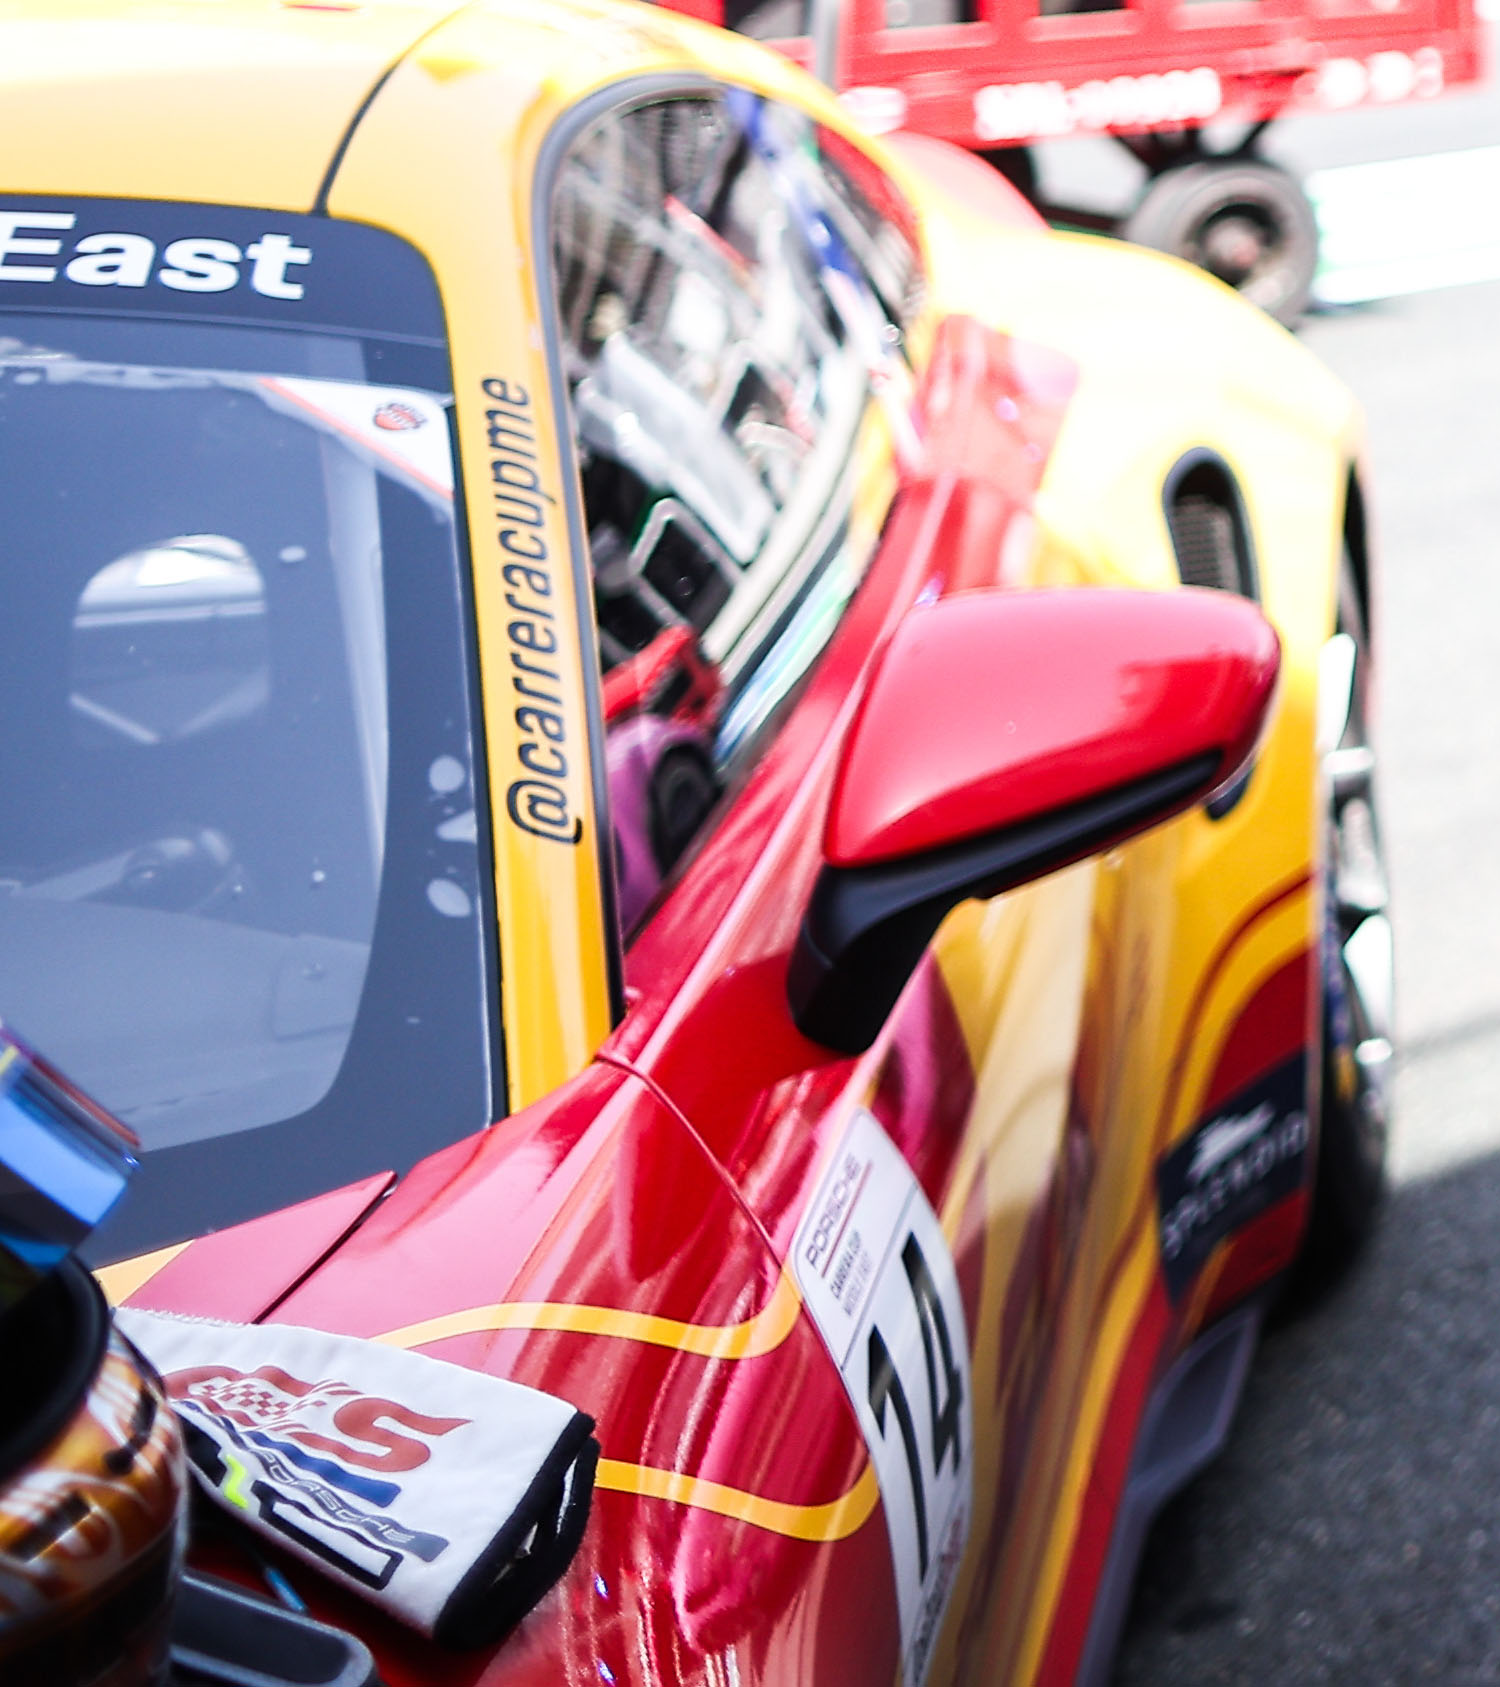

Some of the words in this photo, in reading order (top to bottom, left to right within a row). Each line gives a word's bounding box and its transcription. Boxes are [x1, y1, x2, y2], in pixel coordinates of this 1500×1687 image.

[0, 211, 313, 300] East
[481, 375, 583, 846] @carreracupme
[806, 1153, 860, 1272] PORSCHE
[869, 1231, 966, 1586] 14
[256, 1445, 418, 1546] PORSCHE
